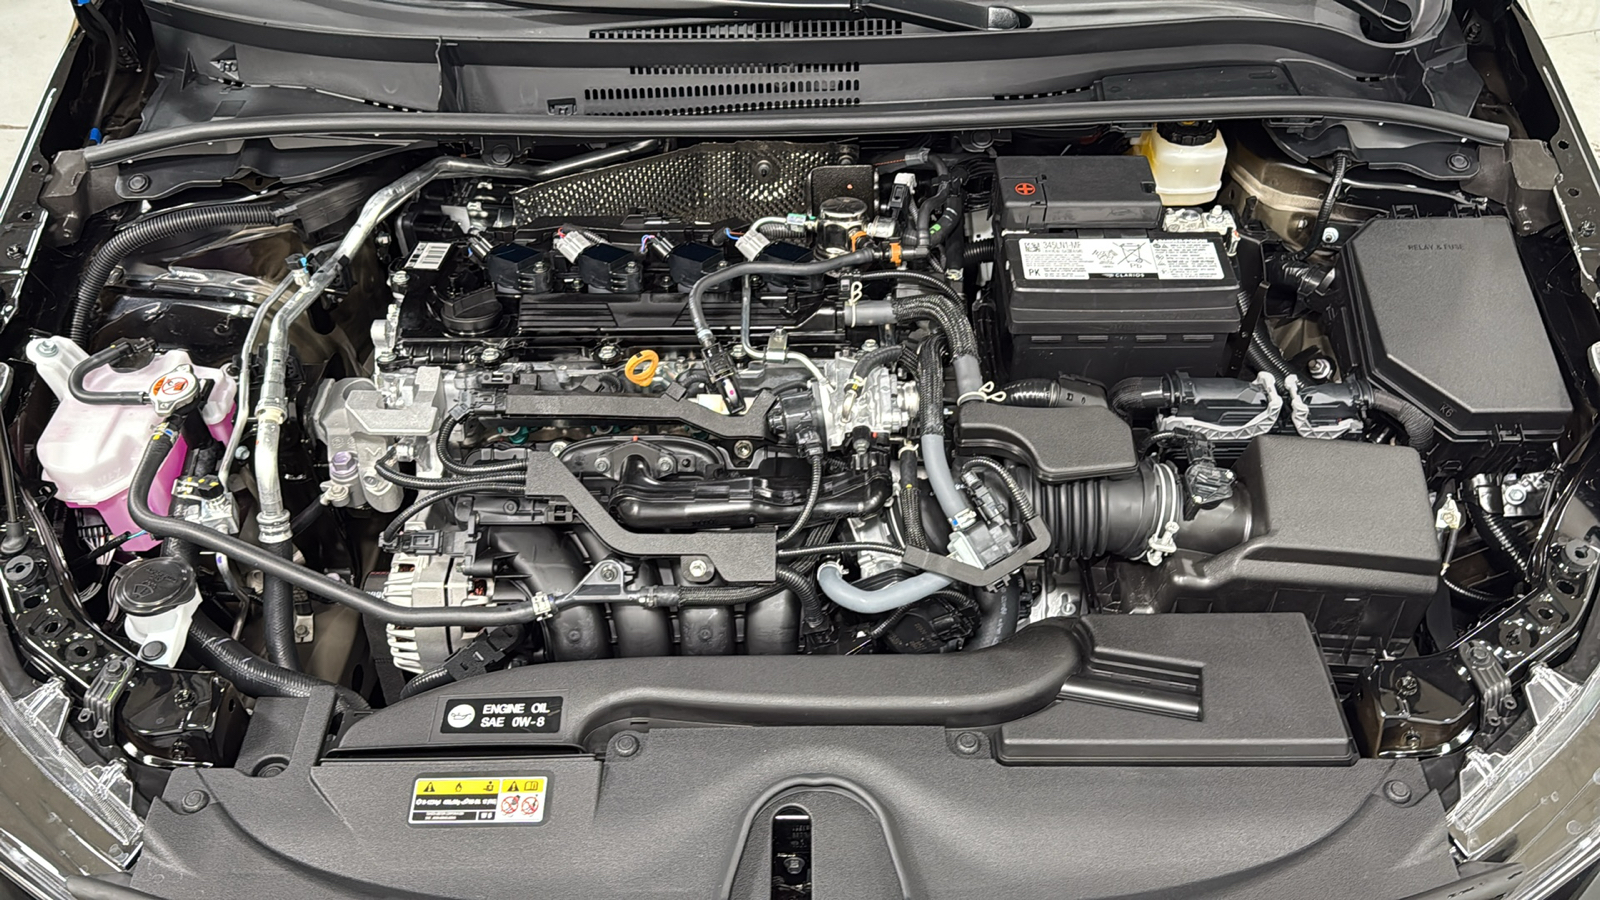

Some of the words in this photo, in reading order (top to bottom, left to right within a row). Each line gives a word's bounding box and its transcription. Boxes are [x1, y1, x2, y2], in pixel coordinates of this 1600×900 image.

[1028, 268, 1041, 277] PK
[1439, 404, 1454, 417] K6
[482, 703, 525, 714] ENGINE
[530, 702, 550, 714] OIL
[480, 716, 506, 728] SAE
[511, 716, 545, 728] 0W-8
